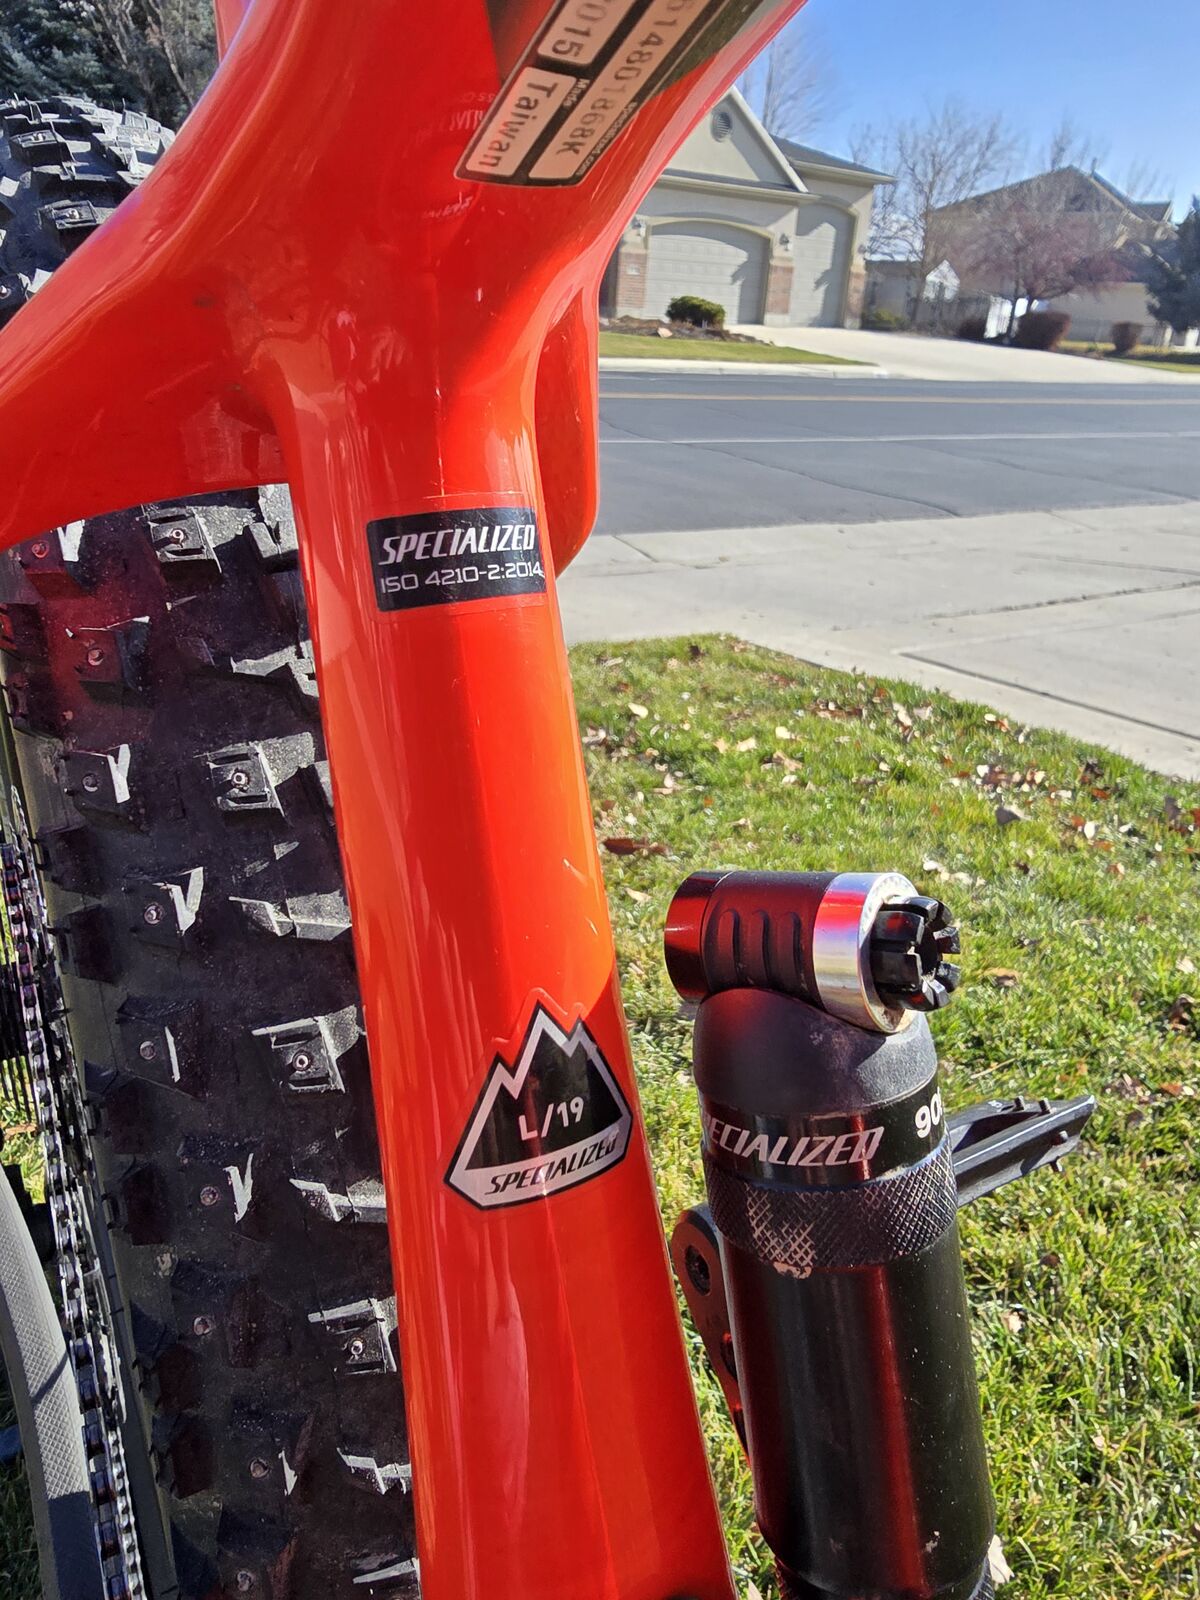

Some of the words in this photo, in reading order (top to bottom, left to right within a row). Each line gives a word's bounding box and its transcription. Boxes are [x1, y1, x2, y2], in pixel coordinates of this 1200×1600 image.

[551, 0, 611, 58] 015
[478, 82, 558, 167] Taiwan
[378, 524, 536, 566] SPECIALIZED
[380, 573, 419, 594] ISO
[424, 561, 545, 587] 4210-2:2014
[518, 1096, 585, 1141] L/19
[484, 1127, 620, 1195] SPECIALIZED
